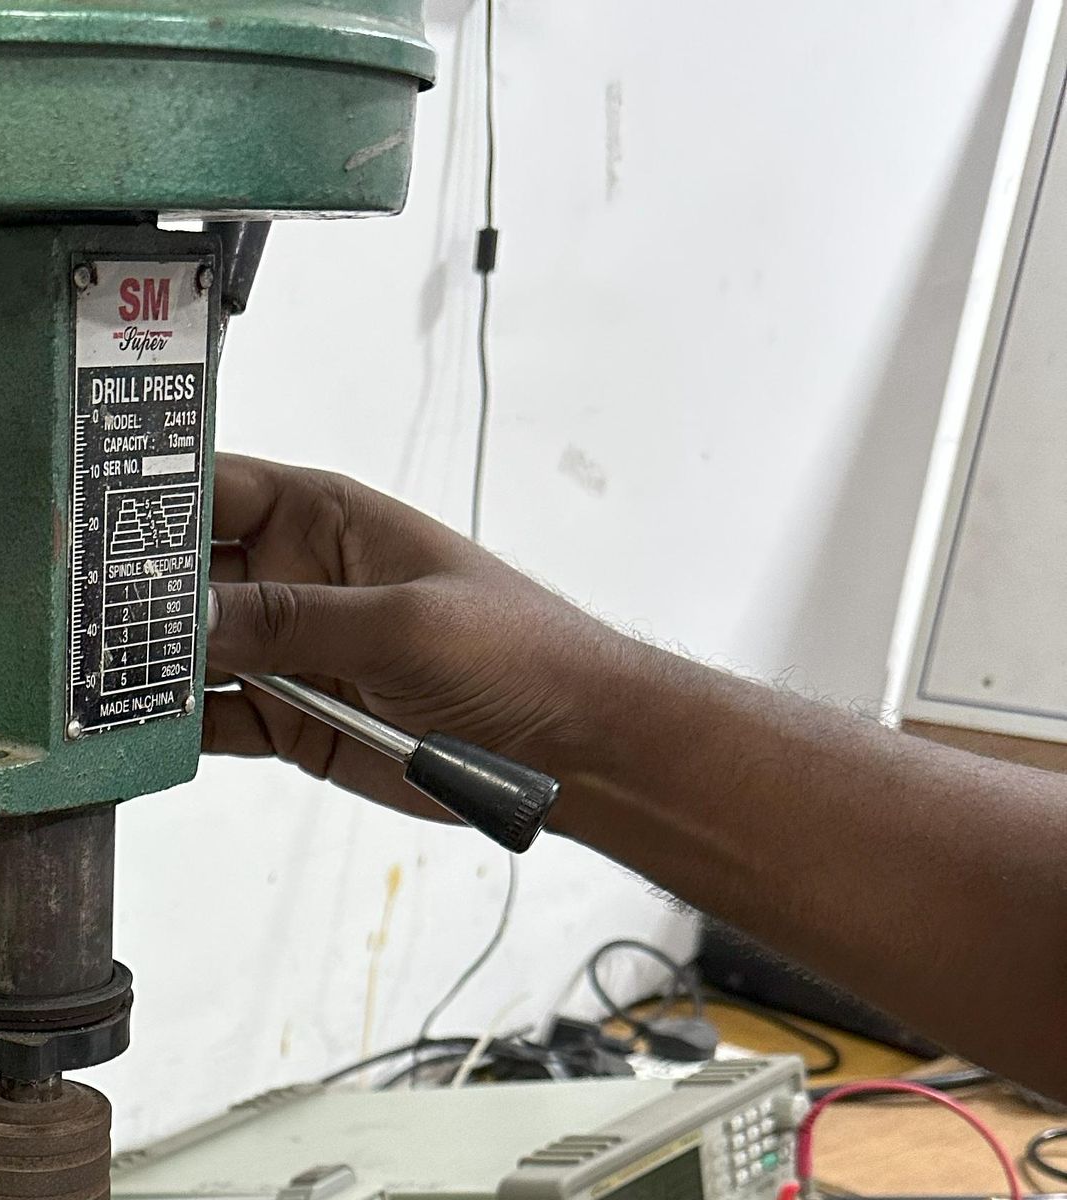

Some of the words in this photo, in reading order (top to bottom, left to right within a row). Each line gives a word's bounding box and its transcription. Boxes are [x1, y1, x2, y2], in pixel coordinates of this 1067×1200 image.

[118, 278, 170, 322] SM
[119, 326, 169, 360] Super
[91, 376, 140, 405] DRILL
[143, 374, 196, 402] PRESS
[164, 410, 197, 428] ZJ4113
[168, 433, 195, 449] 13mm
[90, 464, 100, 479] 10
[102, 460, 121, 476] SER
[123, 458, 140, 474] NO.
[88, 517, 99, 531] 20
[108, 561, 143, 579] SPINDLE
[87, 571, 98, 585] 30
[167, 579, 182, 592] 620
[124, 585, 129, 600] 1
[122, 607, 129, 622] 2
[166, 601, 181, 614] 920
[86, 623, 97, 636] 40
[122, 627, 128, 643] 3
[162, 642, 181, 656] 1750
[121, 651, 127, 665] 4
[161, 663, 181, 678] 2620
[85, 675, 96, 688] 50
[121, 672, 127, 686] 5
[100, 699, 130, 717] MADE
[132, 697, 142, 711] IN
[144, 690, 175, 712] CHINA
